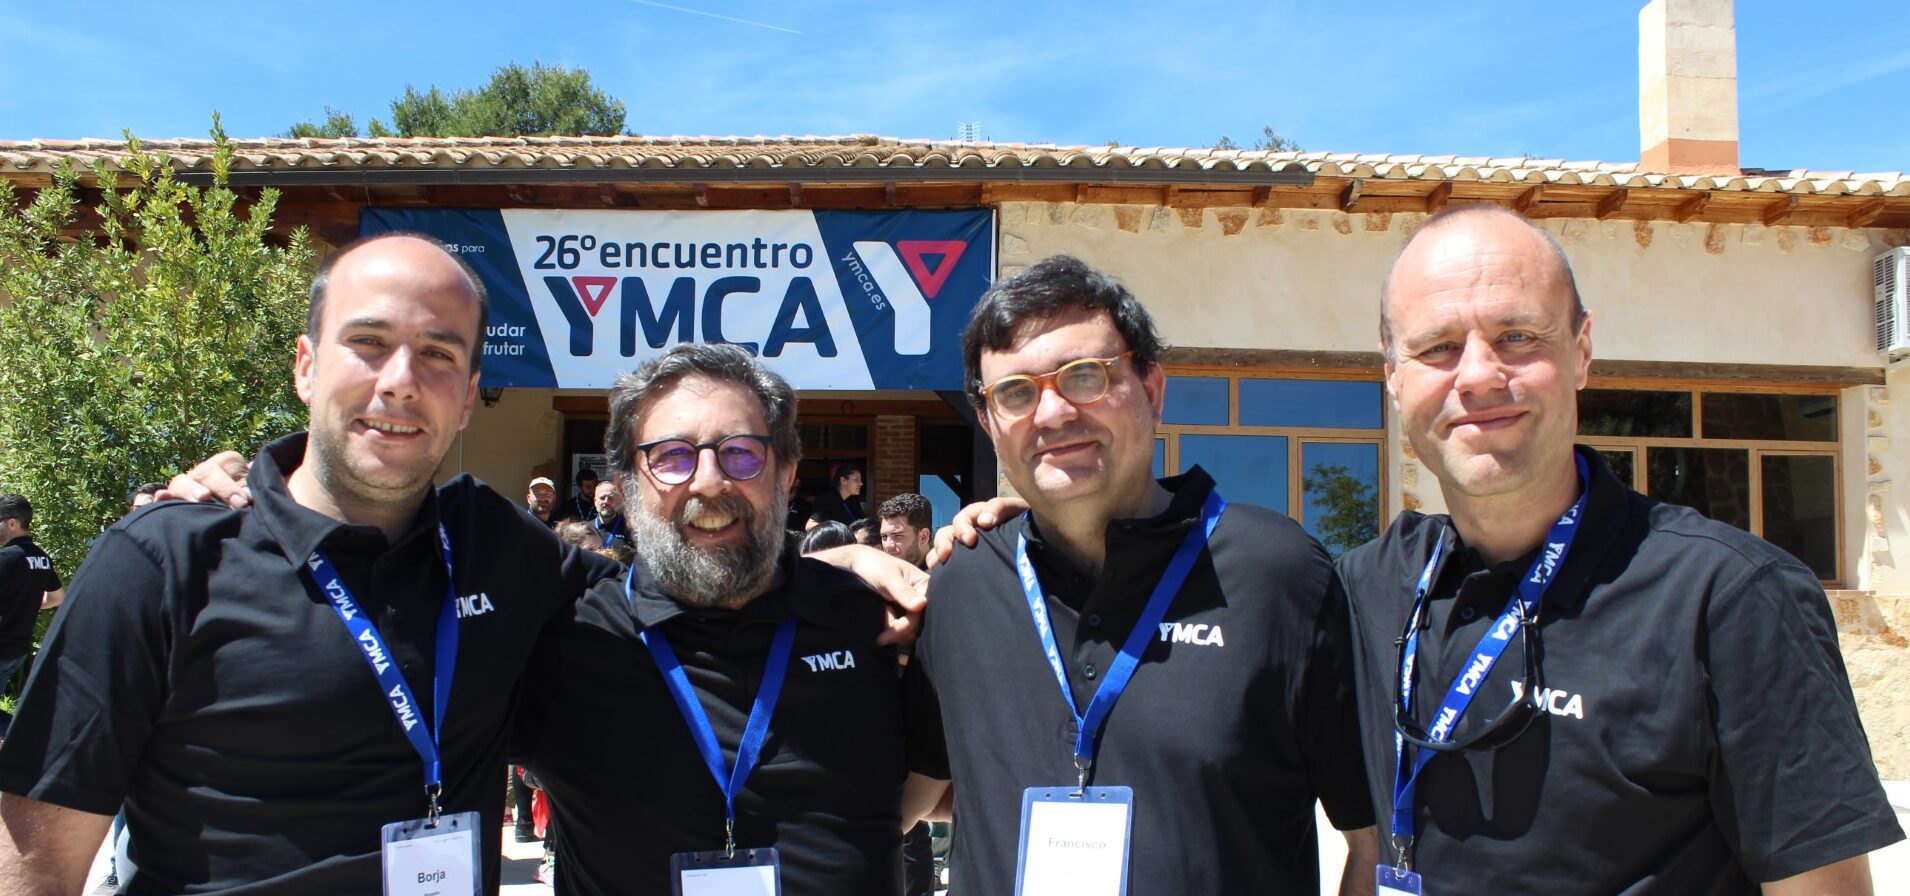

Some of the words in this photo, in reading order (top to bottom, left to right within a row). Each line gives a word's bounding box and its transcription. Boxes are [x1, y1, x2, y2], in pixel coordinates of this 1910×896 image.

[461, 245, 485, 254] para
[599, 237, 814, 269] encuentro
[841, 251, 886, 311] ymca.es
[486, 323, 526, 337] udar
[543, 275, 838, 358] YMCA
[483, 341, 526, 356] frutar
[326, 578, 358, 621] YMCA
[1159, 622, 1225, 647] YMCA
[358, 628, 390, 675] YMCA
[800, 650, 856, 672] YMCA
[1456, 652, 1494, 696] YMCA
[389, 683, 418, 731] YMCA
[1430, 706, 1458, 741] YMC
[1048, 837, 1106, 850] Francisco
[417, 869, 446, 884] Borja
